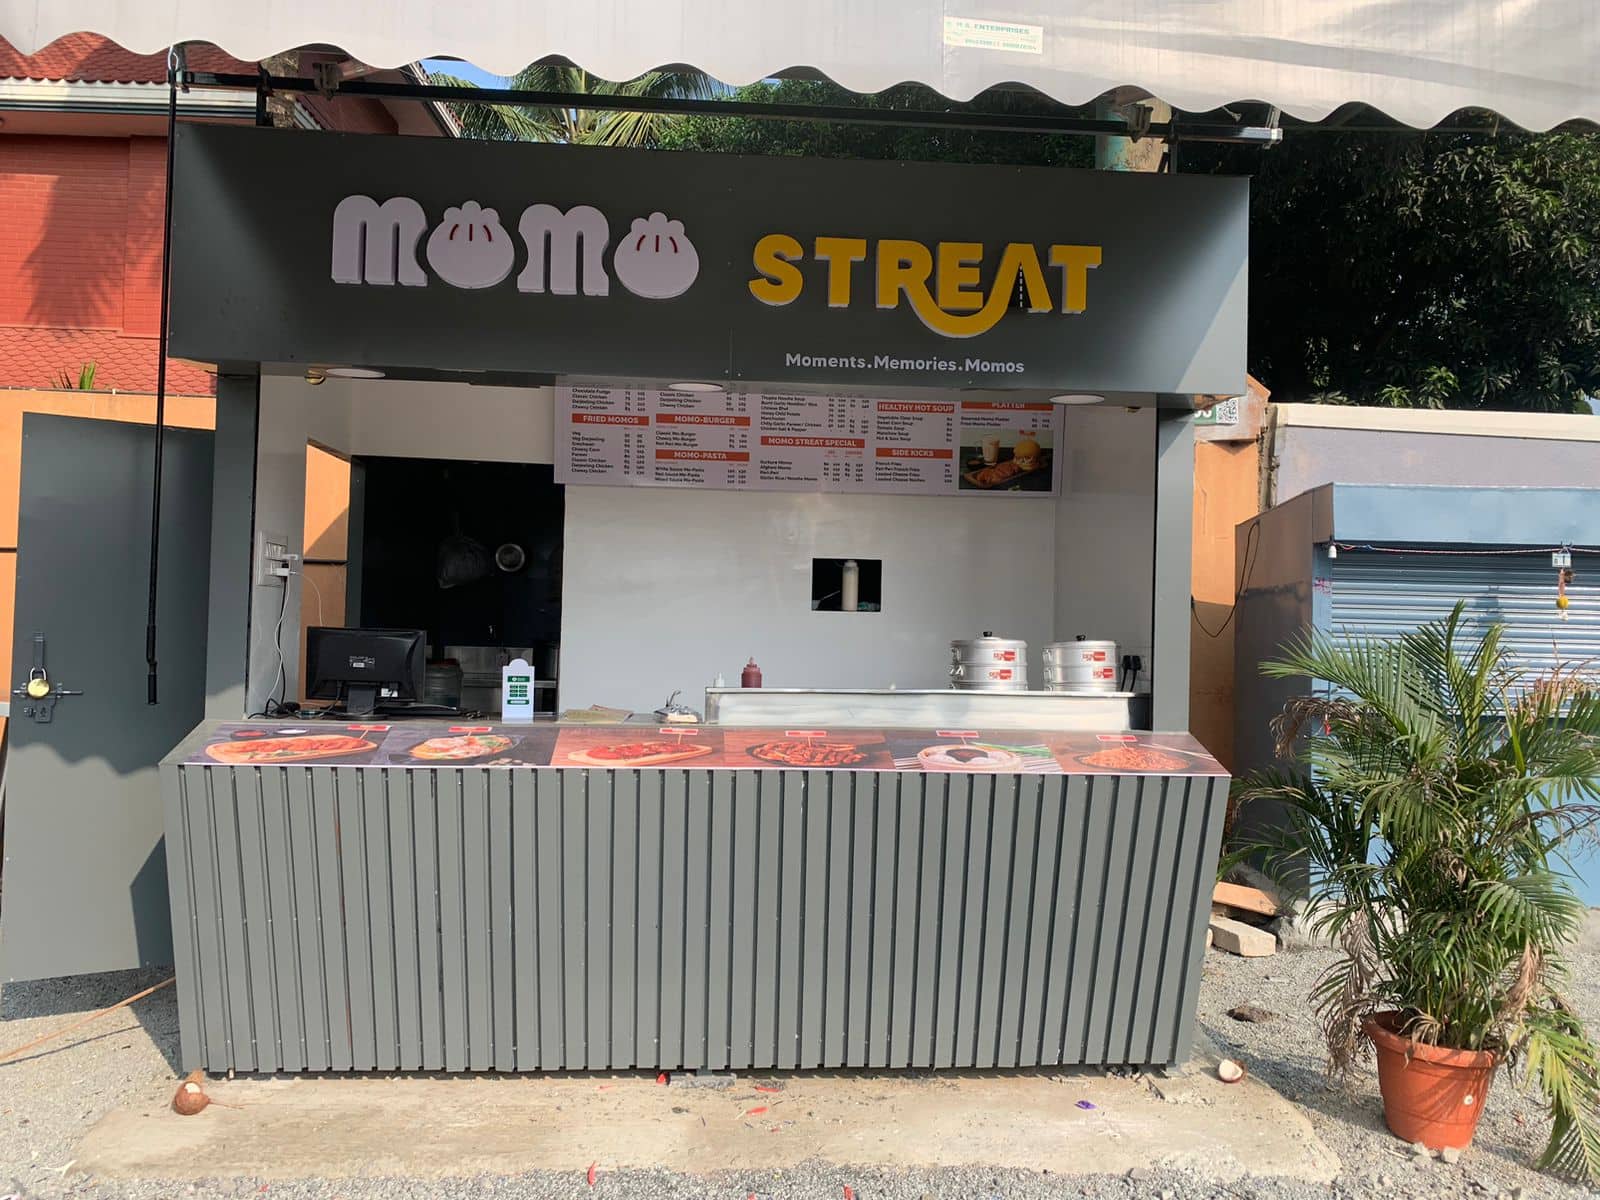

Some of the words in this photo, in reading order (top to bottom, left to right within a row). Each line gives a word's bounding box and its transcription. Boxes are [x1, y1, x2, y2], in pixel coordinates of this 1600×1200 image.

[331, 194, 700, 300] MOMO
[748, 233, 1102, 338] STREAT
[879, 403, 914, 412] HEALTHY
[914, 404, 931, 412] HOT
[932, 405, 954, 413] SOUP
[583, 415, 606, 423] FRIED
[607, 416, 639, 424] MOMOS
[674, 415, 736, 425] MOMO-BURGER
[768, 437, 794, 446] MOMO
[794, 438, 824, 447] STREAT
[825, 439, 857, 447] SPECIAL
[673, 451, 727, 460] MOMO-PASTA
[892, 449, 911, 457] SIDE
